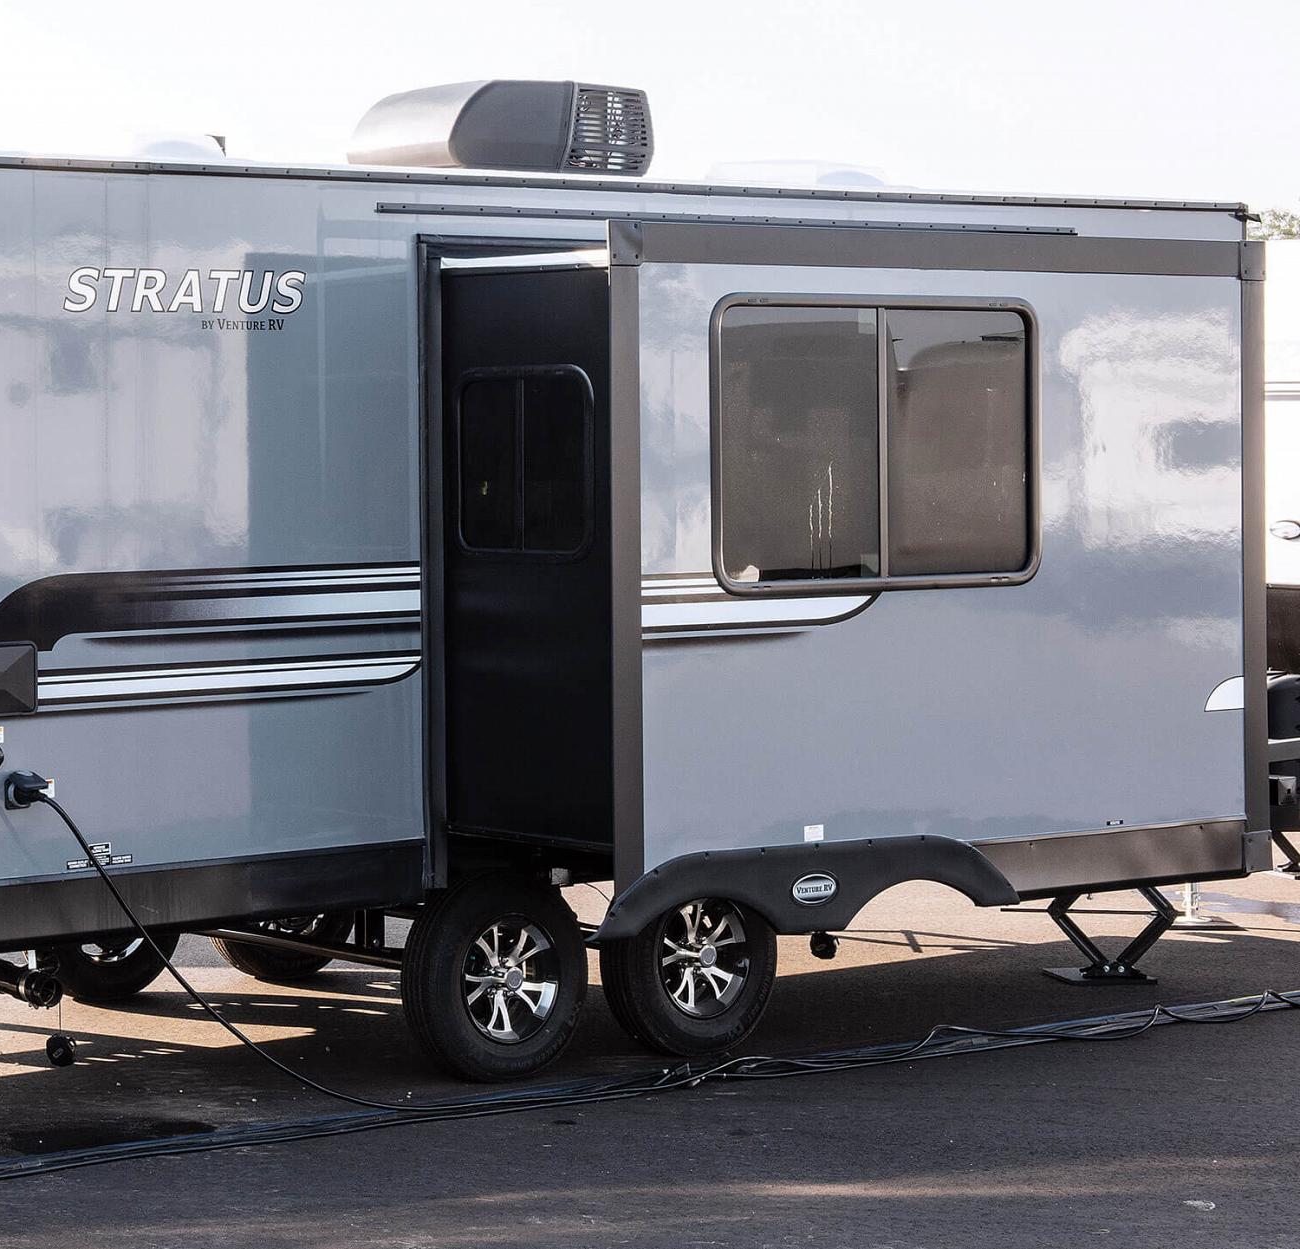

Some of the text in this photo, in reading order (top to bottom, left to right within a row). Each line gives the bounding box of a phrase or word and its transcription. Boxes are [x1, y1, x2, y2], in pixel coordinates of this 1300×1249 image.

[63, 266, 307, 314] STRATUS
[201, 318, 285, 331] BY VENTURE RV
[796, 883, 833, 895] VENTURE RV
